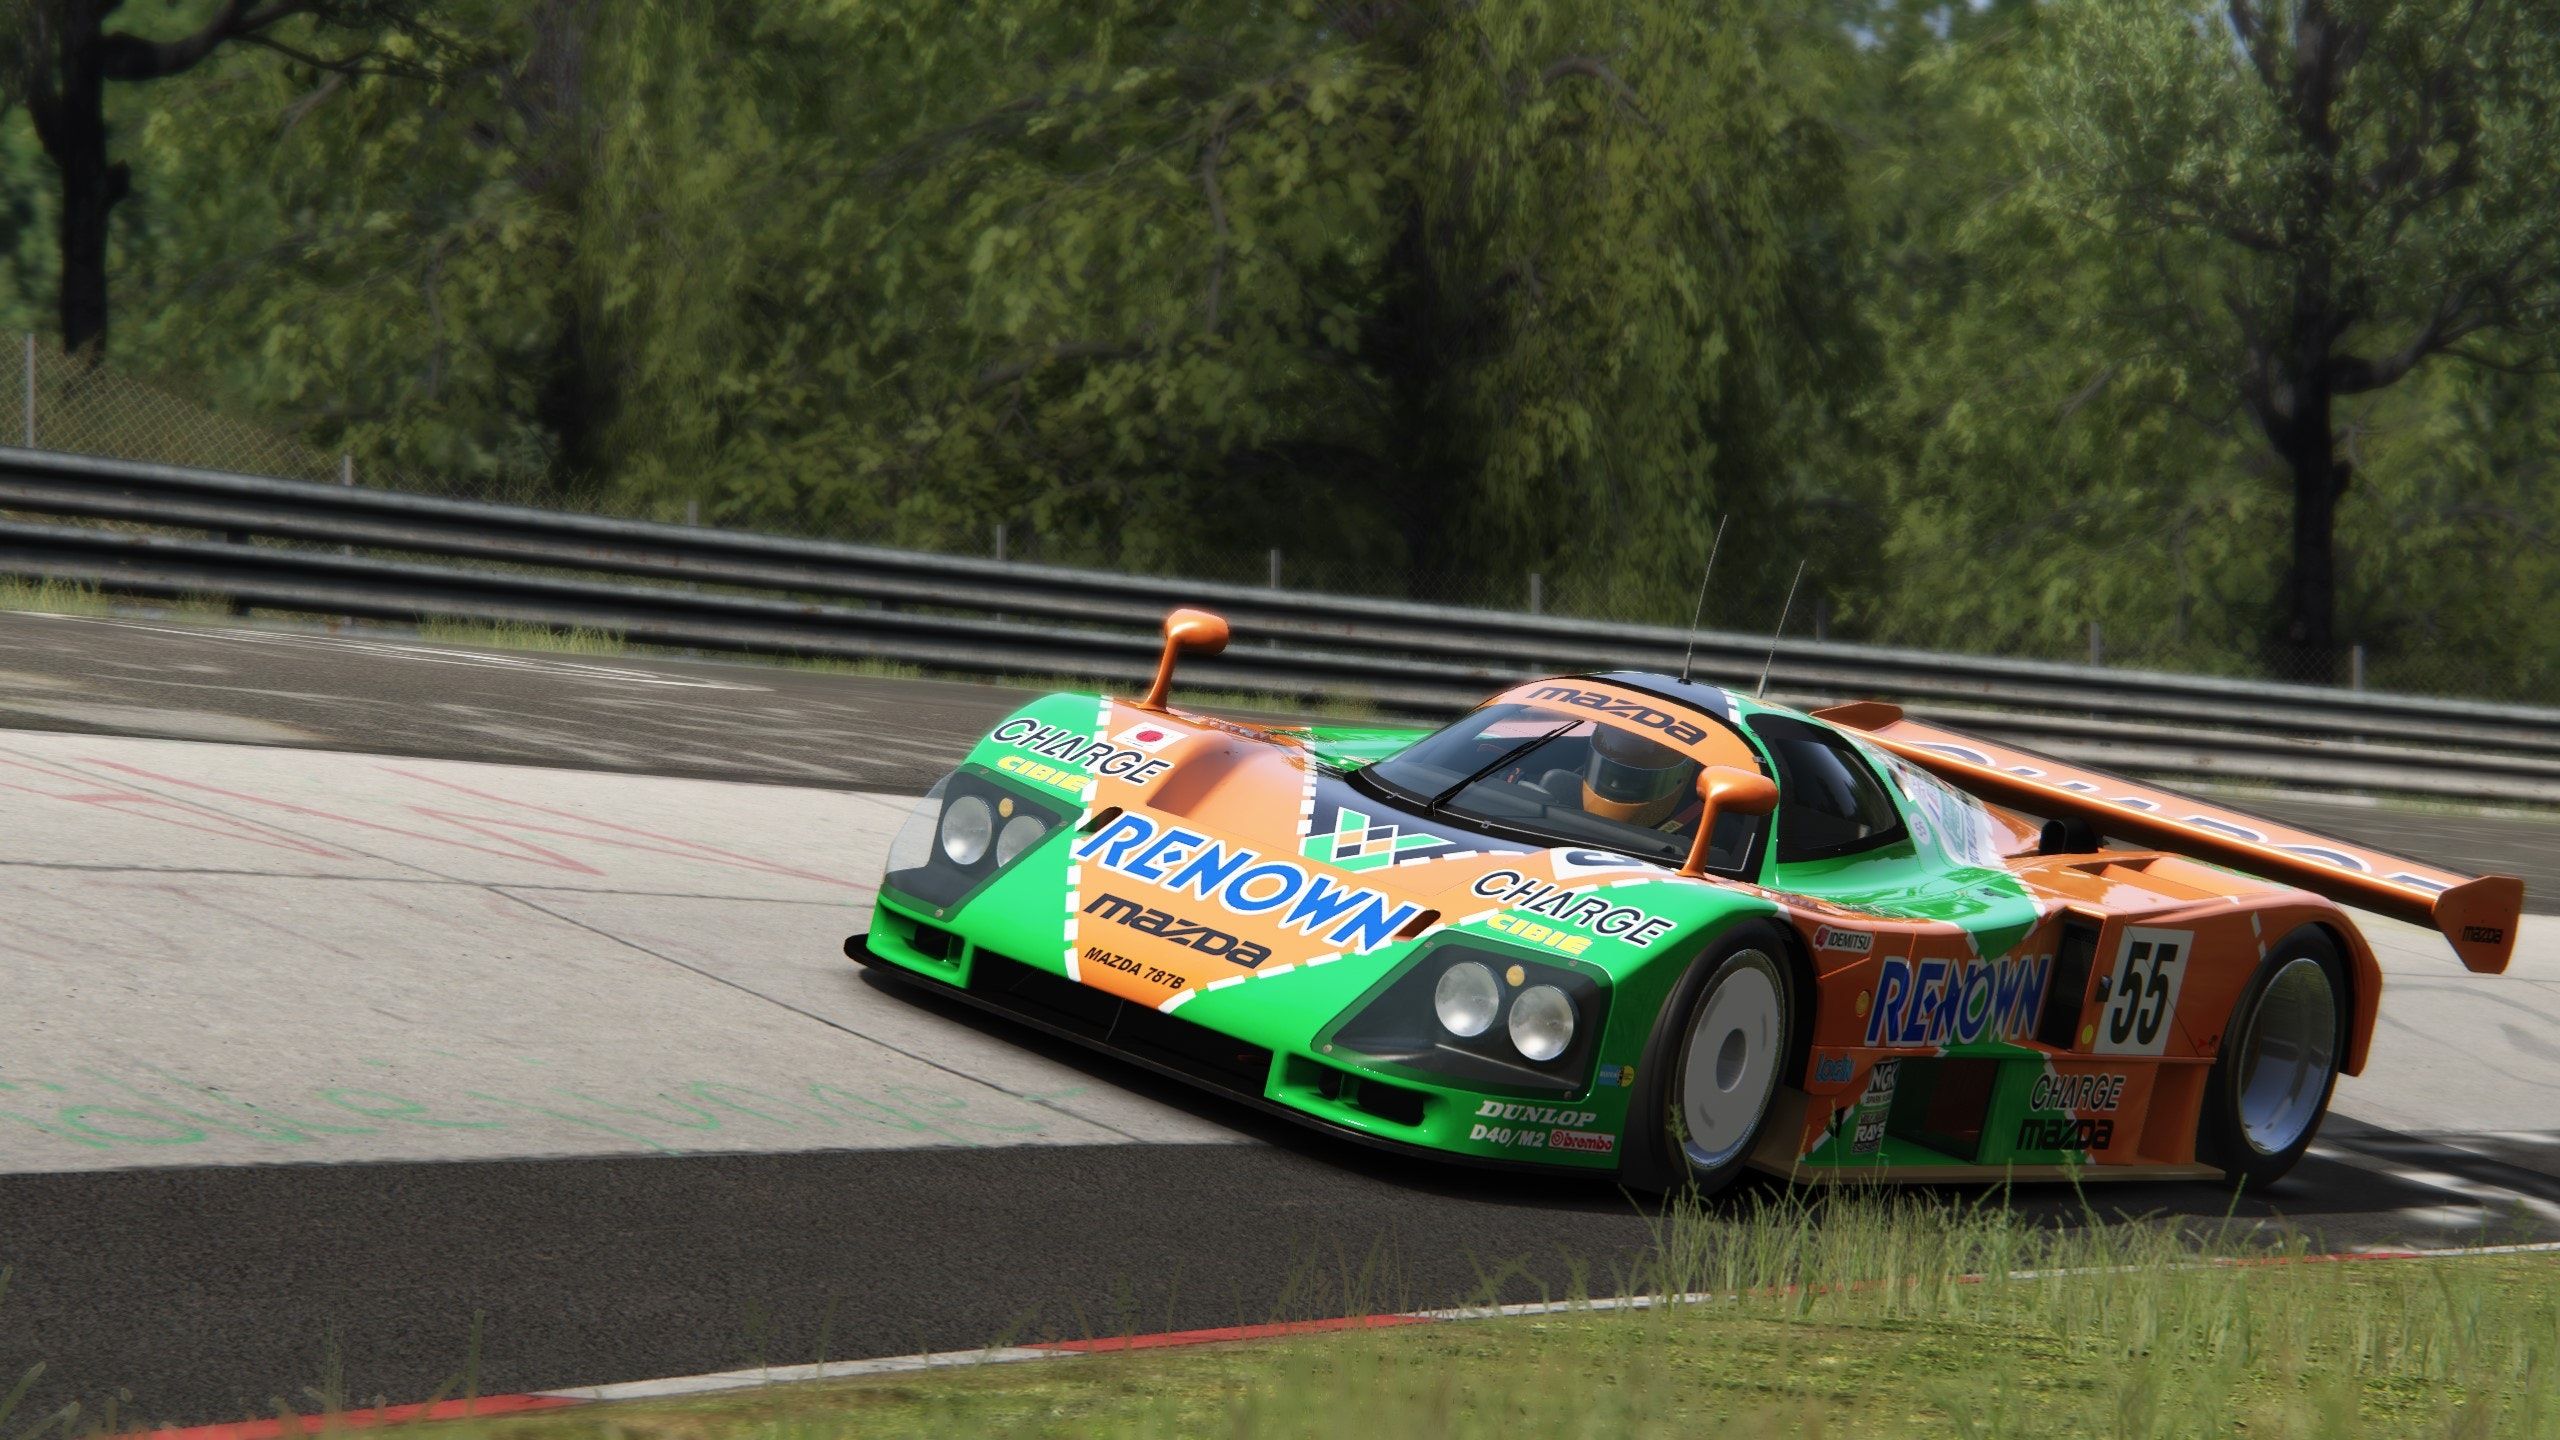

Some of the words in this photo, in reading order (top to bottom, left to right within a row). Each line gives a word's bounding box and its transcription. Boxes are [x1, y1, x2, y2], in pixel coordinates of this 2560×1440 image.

[1526, 687, 1708, 746] mazda
[992, 718, 1175, 786] CHARGE
[997, 754, 1095, 794] CIBIE
[1076, 810, 1429, 955] RENOWN
[1471, 869, 1677, 949] CHARGE
[1083, 893, 1274, 970] mazda
[1486, 912, 1596, 955] CIBIE
[1827, 929, 1872, 952] IDEMITSU
[1084, 946, 1143, 978] MAZDA
[1143, 965, 1187, 991] 787B
[1864, 953, 2054, 1046] RENOWN
[2110, 941, 2180, 1045] 55
[1475, 1100, 1599, 1128] DUNLOP
[2029, 1074, 2126, 1112] CHARGE
[1469, 1124, 1545, 1148] D40/M2
[1563, 1130, 1613, 1151] brembo
[2016, 1118, 2114, 1151] mazda
